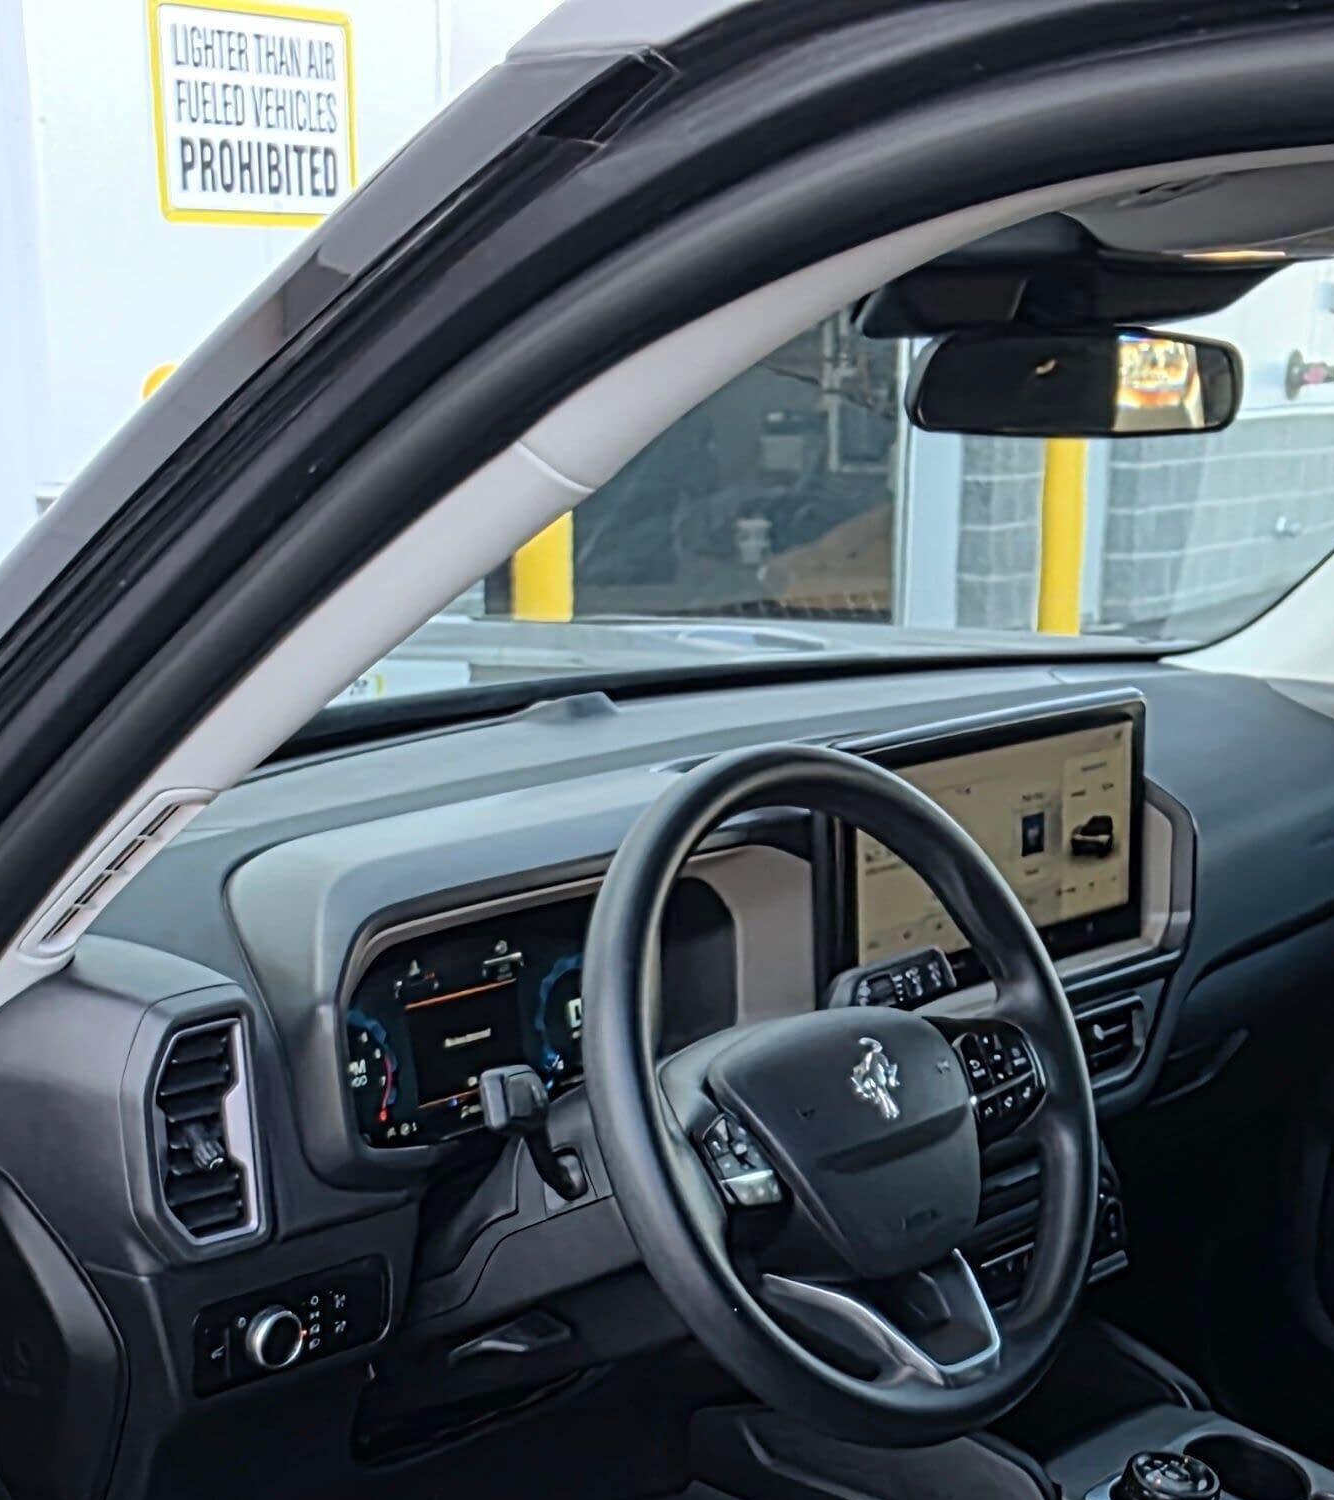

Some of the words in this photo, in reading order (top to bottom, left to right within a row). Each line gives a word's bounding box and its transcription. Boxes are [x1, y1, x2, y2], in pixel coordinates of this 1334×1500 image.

[171, 24, 250, 73] LIGHTER
[253, 33, 302, 77] THAN
[307, 39, 336, 81] AIR
[175, 79, 246, 126] FUELED
[250, 85, 338, 134] VEHICLES
[179, 136, 338, 198] PROHIBITED
